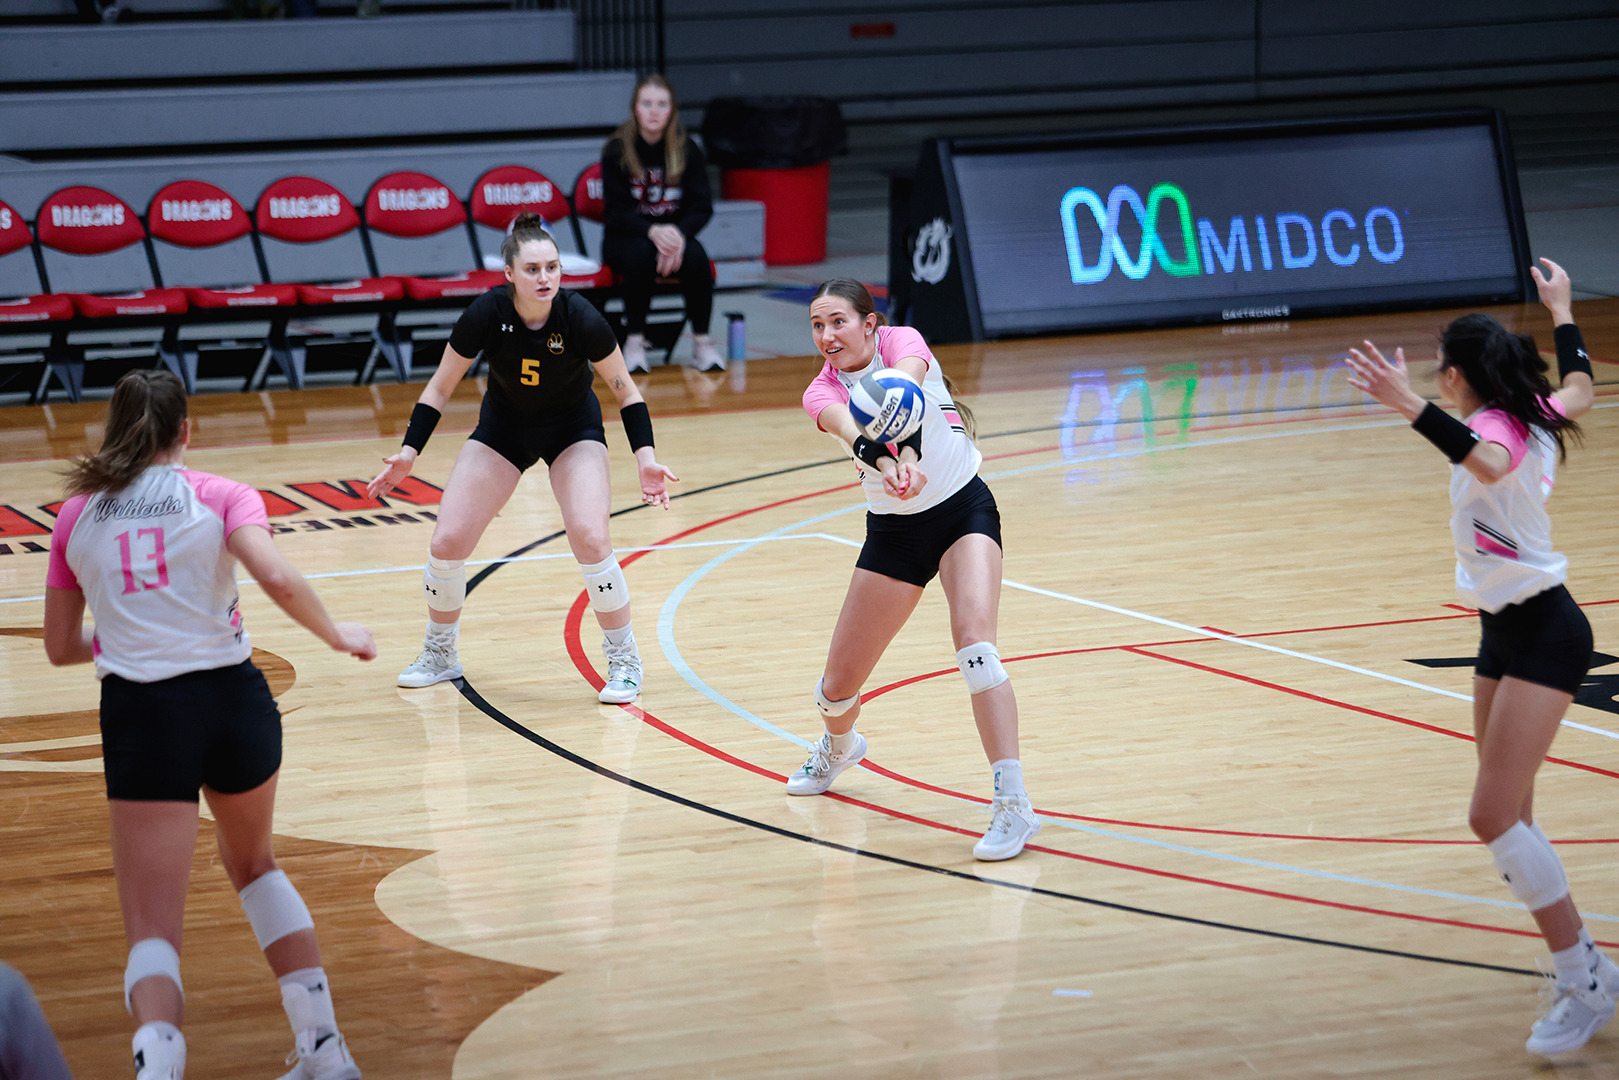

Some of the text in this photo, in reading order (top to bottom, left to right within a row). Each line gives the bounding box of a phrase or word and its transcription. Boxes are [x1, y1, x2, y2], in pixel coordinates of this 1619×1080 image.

[51, 203, 125, 228] DRAGONS
[162, 199, 233, 221] DRAGONS
[1197, 206, 1406, 276] MIDCO
[520, 358, 540, 387] 5
[873, 396, 899, 434] molten
[94, 495, 184, 523] Wildcats
[114, 527, 170, 596] 13
